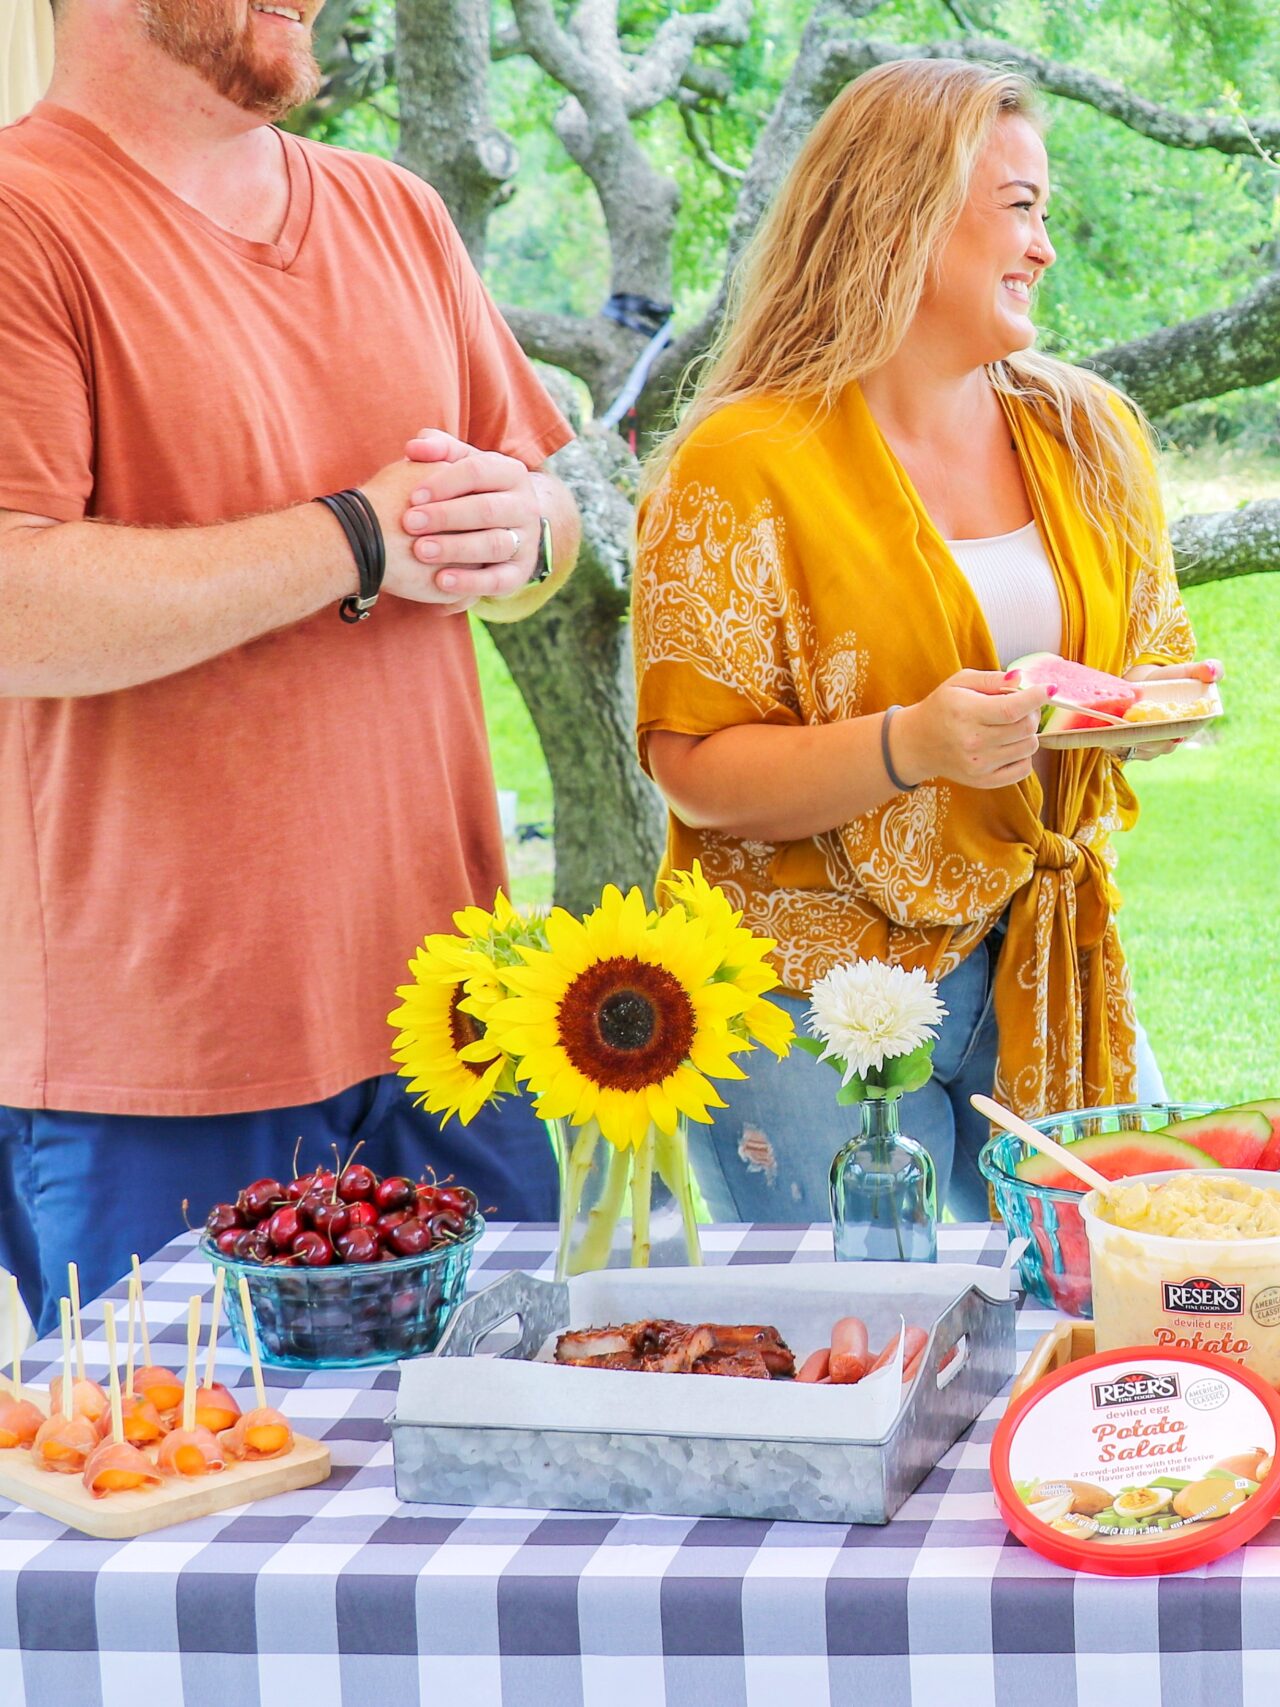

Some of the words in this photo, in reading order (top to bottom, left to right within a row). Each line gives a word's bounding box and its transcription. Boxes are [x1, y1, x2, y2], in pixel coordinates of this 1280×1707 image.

[1167, 1285, 1239, 1311] RESER'S
[1174, 1318, 1211, 1329] deviled
[1214, 1320, 1233, 1330] egg
[1153, 1327, 1253, 1353] Potato
[1099, 1376, 1175, 1406] RESER'S
[1188, 1384, 1224, 1397] AMERICAN
[1191, 1391, 1225, 1406] CLASSICS
[1106, 1406, 1147, 1420] deviled
[1149, 1404, 1171, 1415] egg
[1092, 1415, 1188, 1443] Potato
[1098, 1434, 1188, 1463] Salad
[1080, 1463, 1143, 1478] crowd-pleaser
[1145, 1460, 1166, 1469] with
[1167, 1458, 1182, 1467] the
[1184, 1453, 1214, 1464] festive
[1098, 1474, 1124, 1482] flavor
[1136, 1467, 1169, 1477] deviled
[1170, 1464, 1191, 1473] eggs
[1099, 1526, 1111, 1534] OZ
[1110, 1527, 1119, 1536] (3
